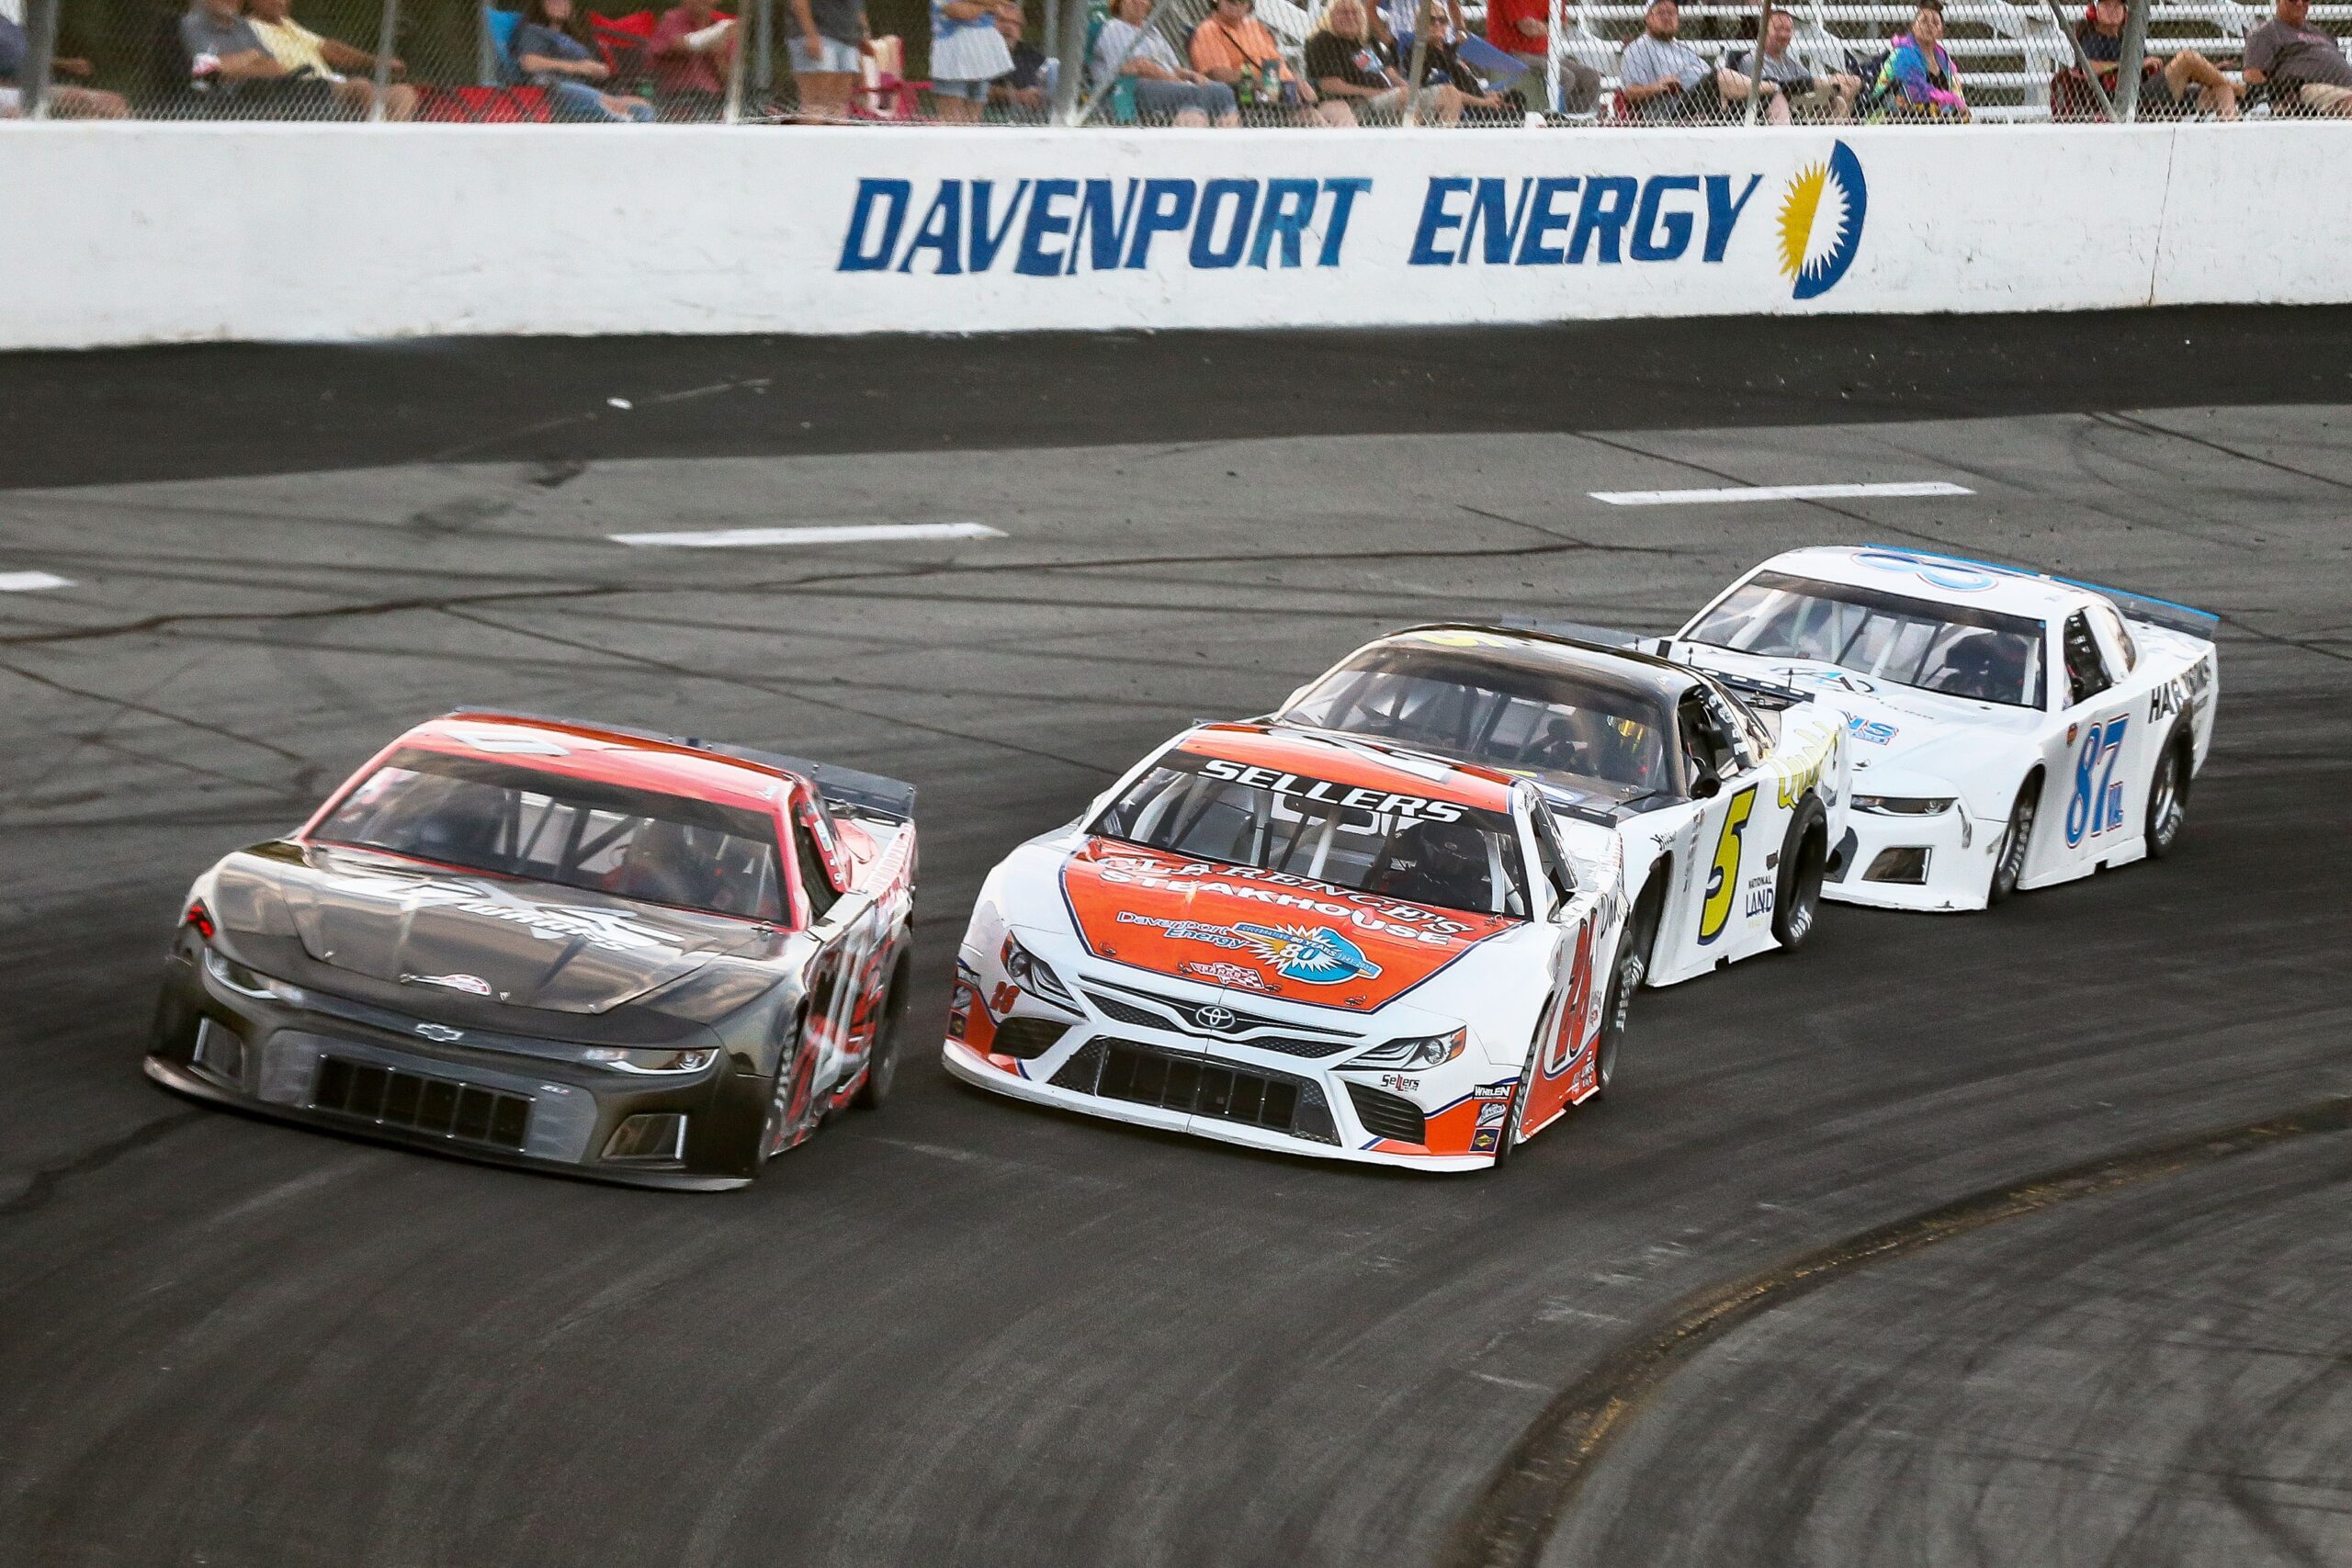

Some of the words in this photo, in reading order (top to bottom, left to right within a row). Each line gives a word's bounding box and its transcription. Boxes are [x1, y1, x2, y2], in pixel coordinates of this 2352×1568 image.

[835, 176, 1372, 276] DAVENPORT
[1409, 173, 1761, 266] ENERGY
[1198, 759, 1469, 823] SELLERS
[2065, 713, 2130, 849] 87
[1697, 782, 1759, 946] 5
[1099, 871, 1453, 945] STEAKHOUSE
[1746, 888, 1774, 918] LAND
[1117, 911, 1229, 935] Davenport
[1164, 928, 1250, 949] Energy
[1279, 942, 1320, 962] 80
[1304, 941, 1338, 959] YEARS
[1380, 1074, 1420, 1092] Sellers
